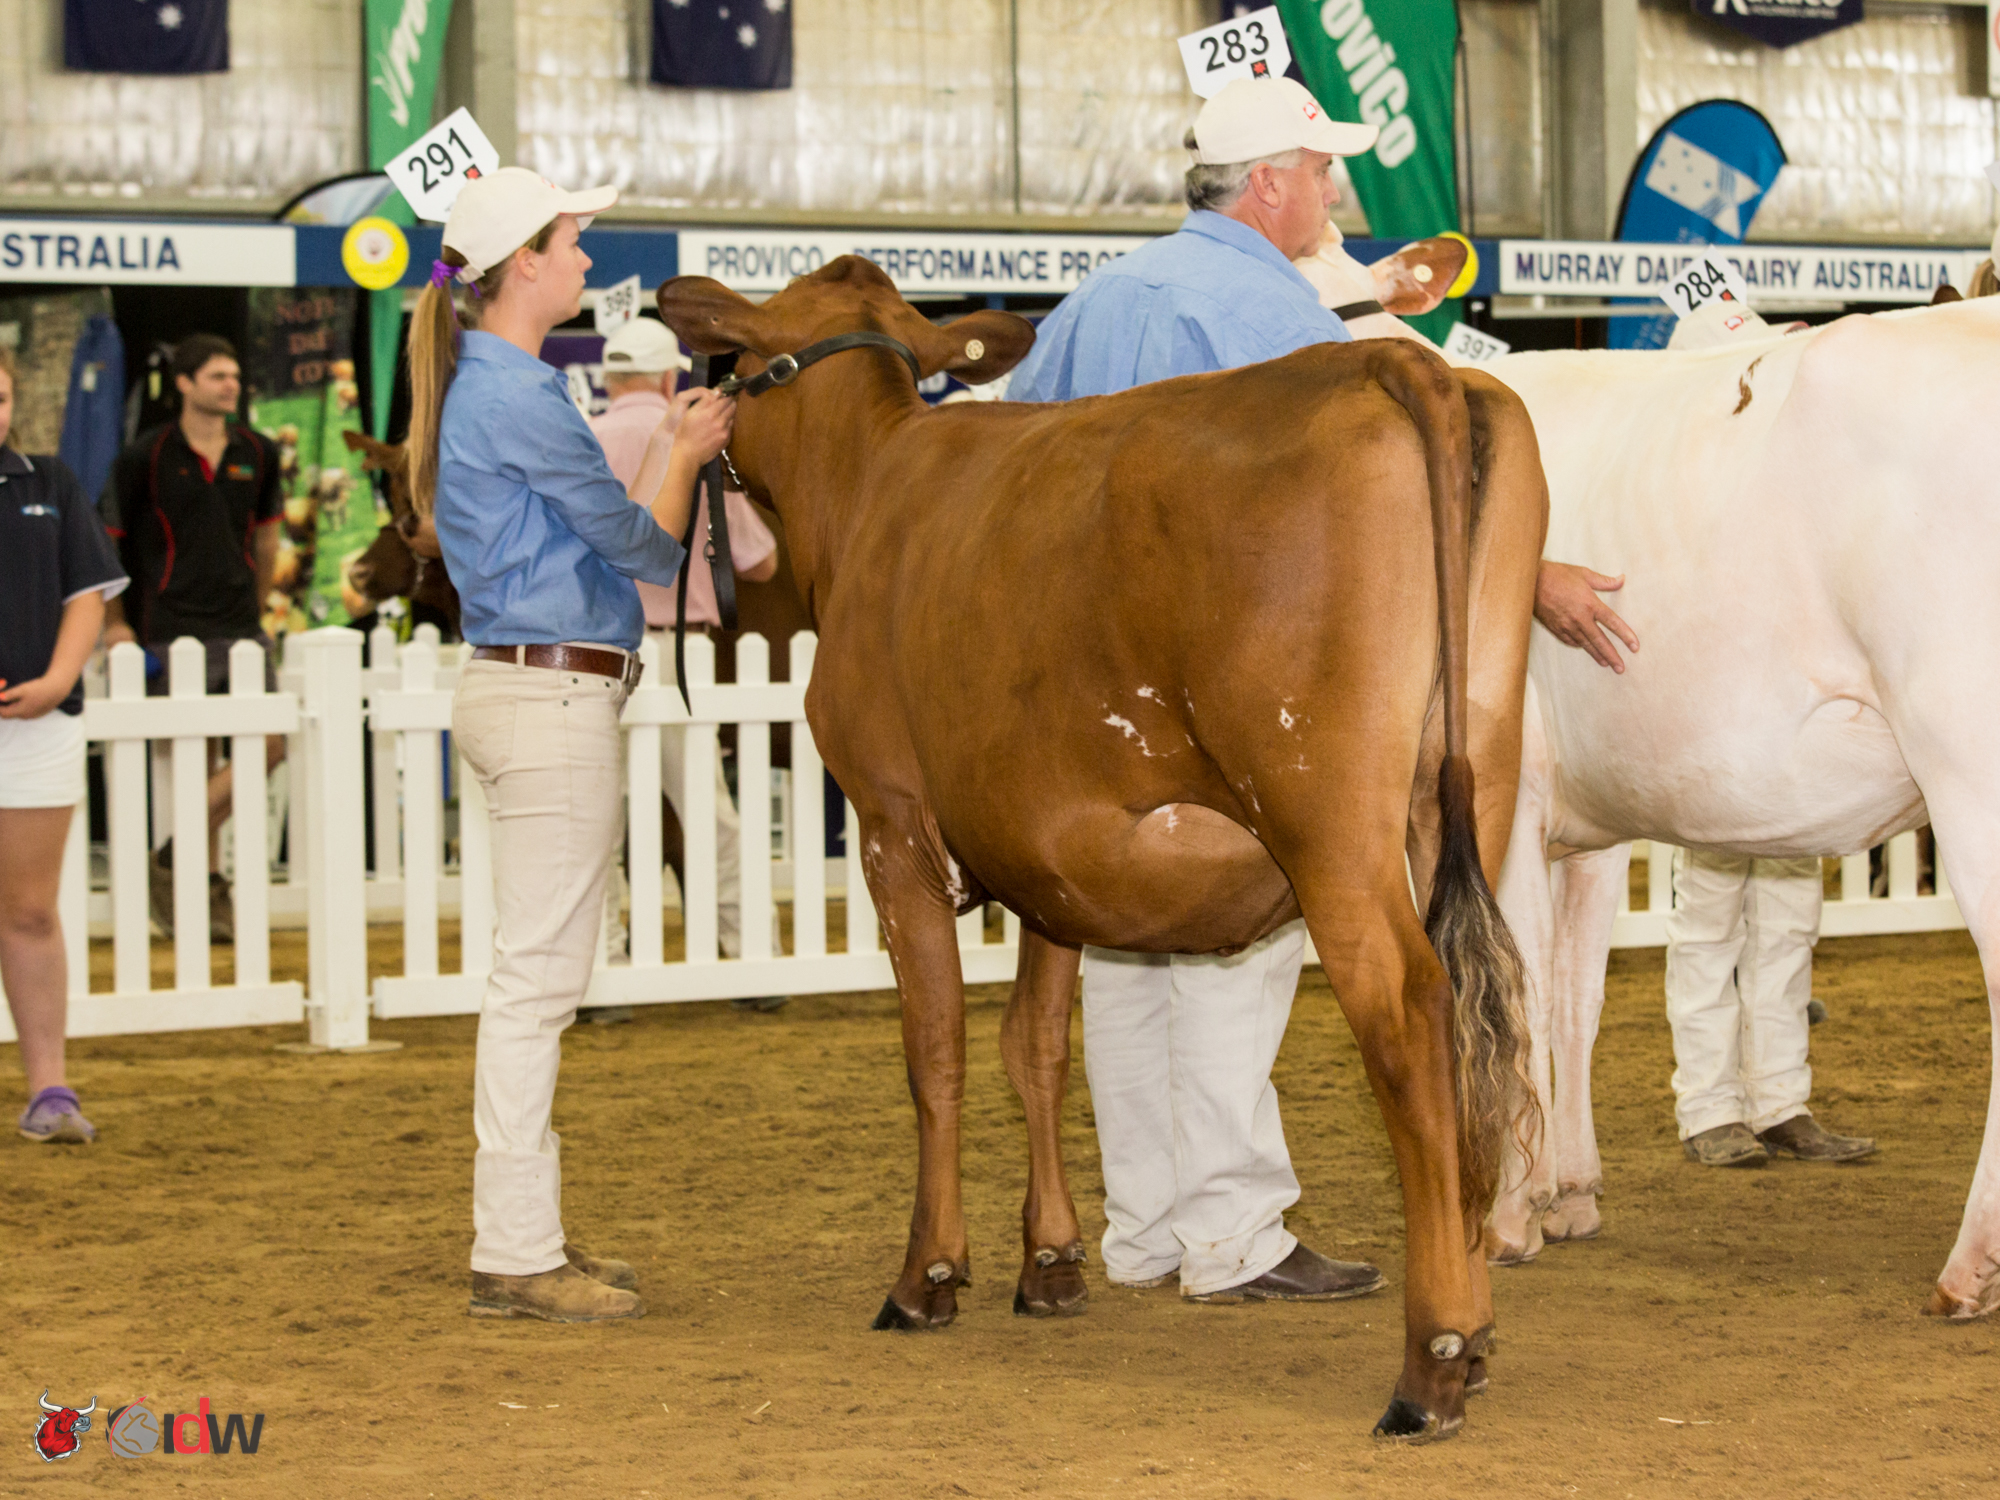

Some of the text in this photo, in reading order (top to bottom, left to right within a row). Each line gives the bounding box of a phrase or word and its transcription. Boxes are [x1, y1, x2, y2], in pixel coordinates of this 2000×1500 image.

[1200, 21, 1269, 73] 283
[408, 127, 473, 194] 291
[706, 245, 824, 277] PROVICO
[1515, 253, 1624, 283] MURRAY
[1815, 260, 1951, 290] AUSTRALIA
[1674, 259, 1726, 311] 284
[1457, 333, 1498, 361] 397
